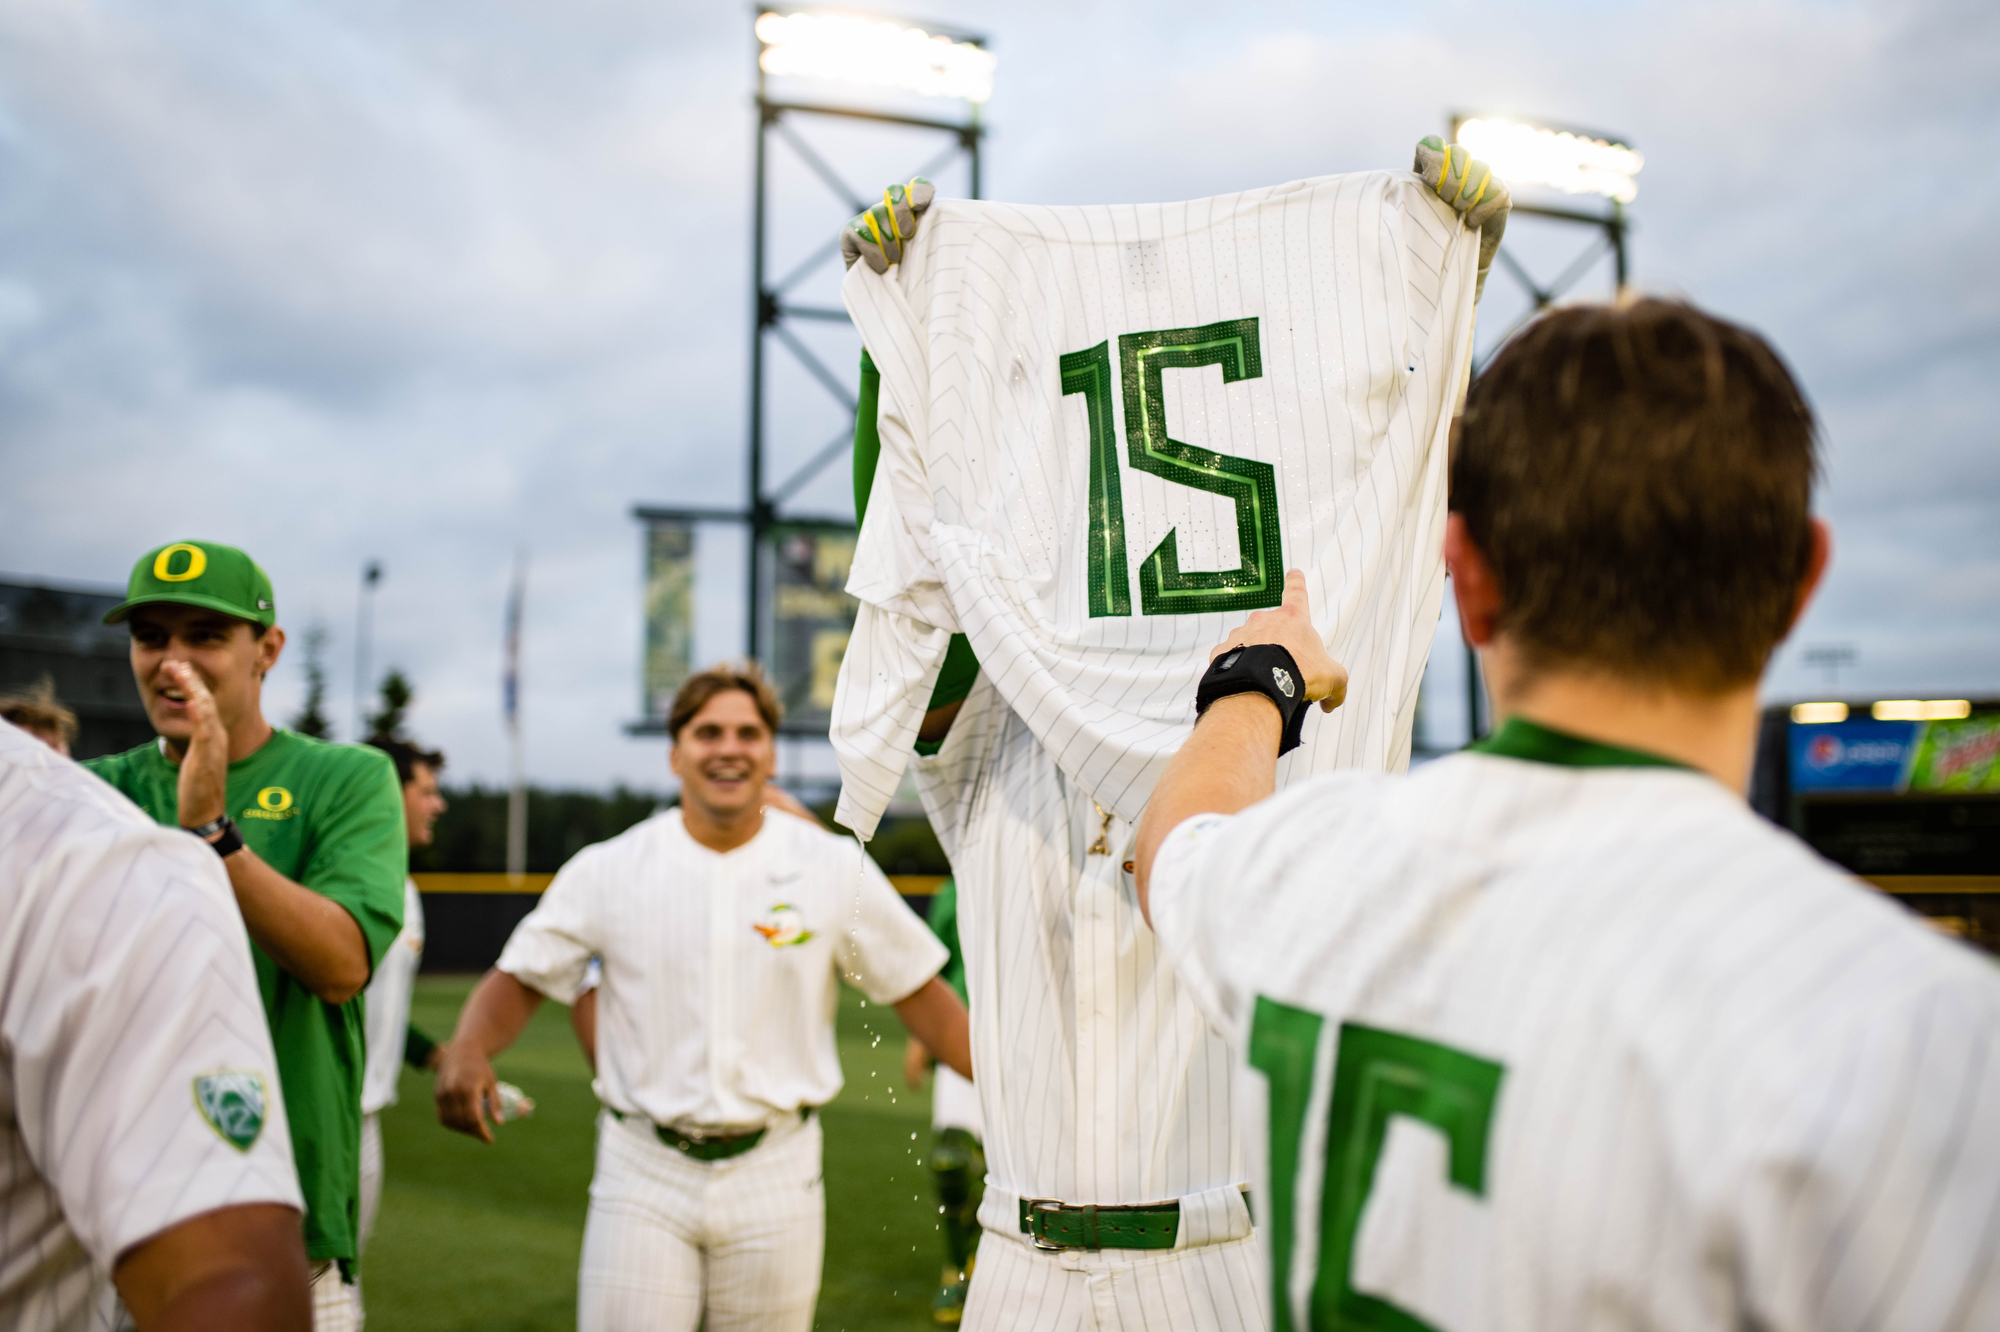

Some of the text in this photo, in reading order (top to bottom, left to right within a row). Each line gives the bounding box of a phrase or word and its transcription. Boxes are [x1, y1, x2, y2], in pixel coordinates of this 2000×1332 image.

[1059, 316, 1285, 619] 15
[153, 543, 207, 582] O
[257, 786, 293, 812] O
